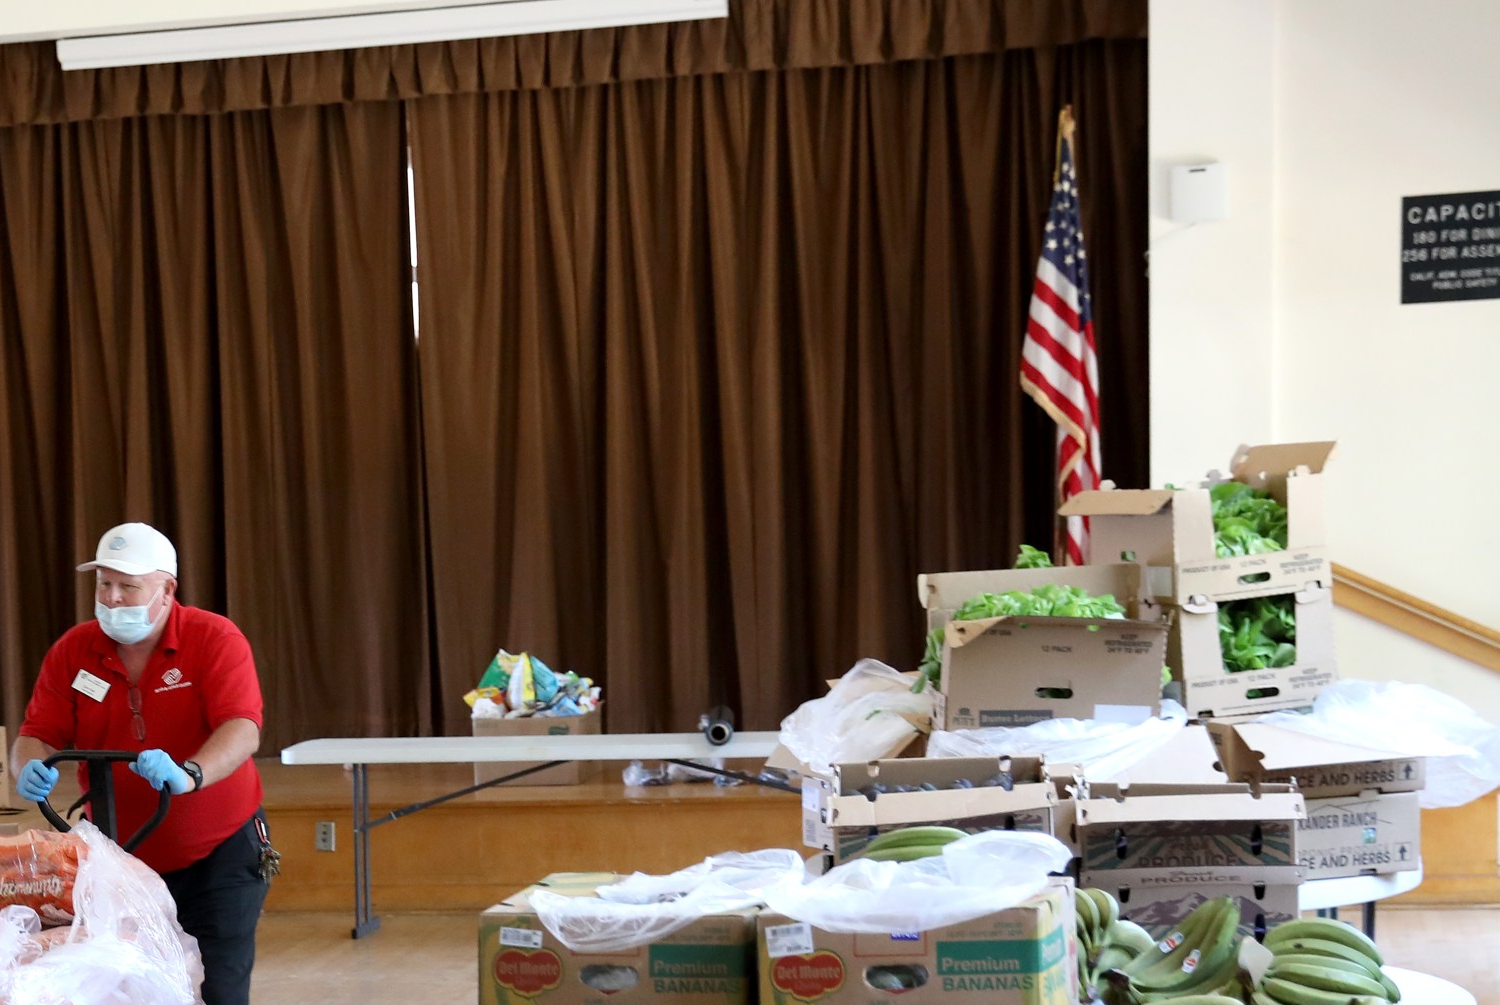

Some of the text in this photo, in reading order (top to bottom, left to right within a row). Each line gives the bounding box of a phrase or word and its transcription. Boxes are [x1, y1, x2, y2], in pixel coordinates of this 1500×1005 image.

[1440, 228, 1468, 242] FOR
[1431, 246, 1458, 260] FOR
[1320, 774, 1350, 787] AND
[1354, 770, 1395, 783] HERBS
[1297, 811, 1377, 831] XANDER RANCH
[1138, 853, 1239, 867] PRODUCE
[1319, 853, 1349, 868] AND
[1352, 851, 1391, 865] HERBS
[1140, 875, 1242, 884] PRODUCE
[500, 960, 558, 977] Del Monte
[654, 960, 728, 975] Premium
[942, 957, 1020, 972] Premium
[777, 965, 841, 980] Del Monte
[654, 979, 742, 994] BANANAS
[943, 976, 1034, 992] BANANAS
